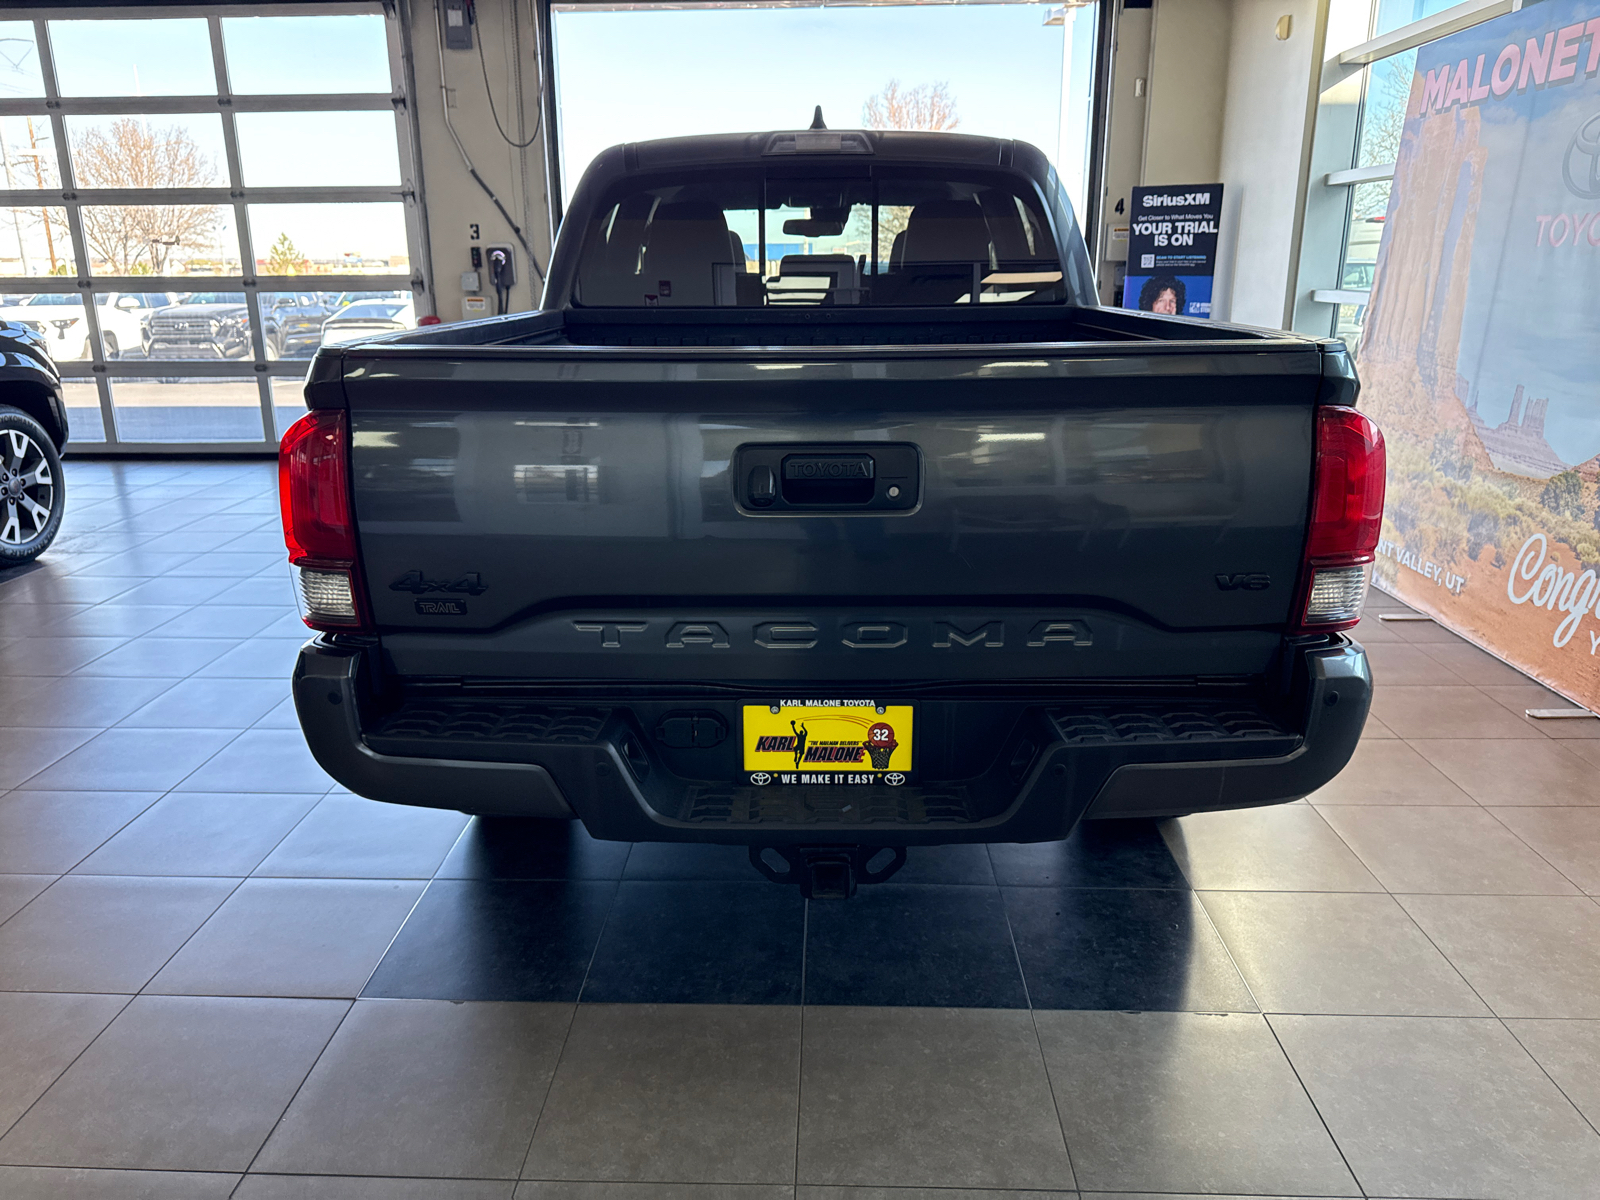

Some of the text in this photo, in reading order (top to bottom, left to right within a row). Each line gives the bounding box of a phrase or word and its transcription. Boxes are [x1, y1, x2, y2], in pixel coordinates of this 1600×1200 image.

[1114, 197, 1125, 215] 4
[1142, 192, 1211, 207] SiriusXM
[469, 223, 480, 240] 3
[1132, 221, 1172, 235] YOUR
[1174, 220, 1218, 234] TRIAL
[1154, 233, 1194, 247] IS ON
[789, 461, 870, 478] TOYOTA
[1396, 546, 1442, 587] VALLEY,
[1445, 572, 1465, 593] UT
[388, 569, 490, 596] 4x4
[1215, 573, 1270, 591] V6
[418, 601, 461, 614] TRAIL
[572, 620, 1094, 649] TACOMA
[780, 699, 876, 707] KARL MALONE TOYOTA
[873, 728, 889, 741] 32
[755, 736, 798, 752] KARL
[803, 746, 866, 763] MALONE
[781, 774, 875, 784] WE MAKE IT EASY
